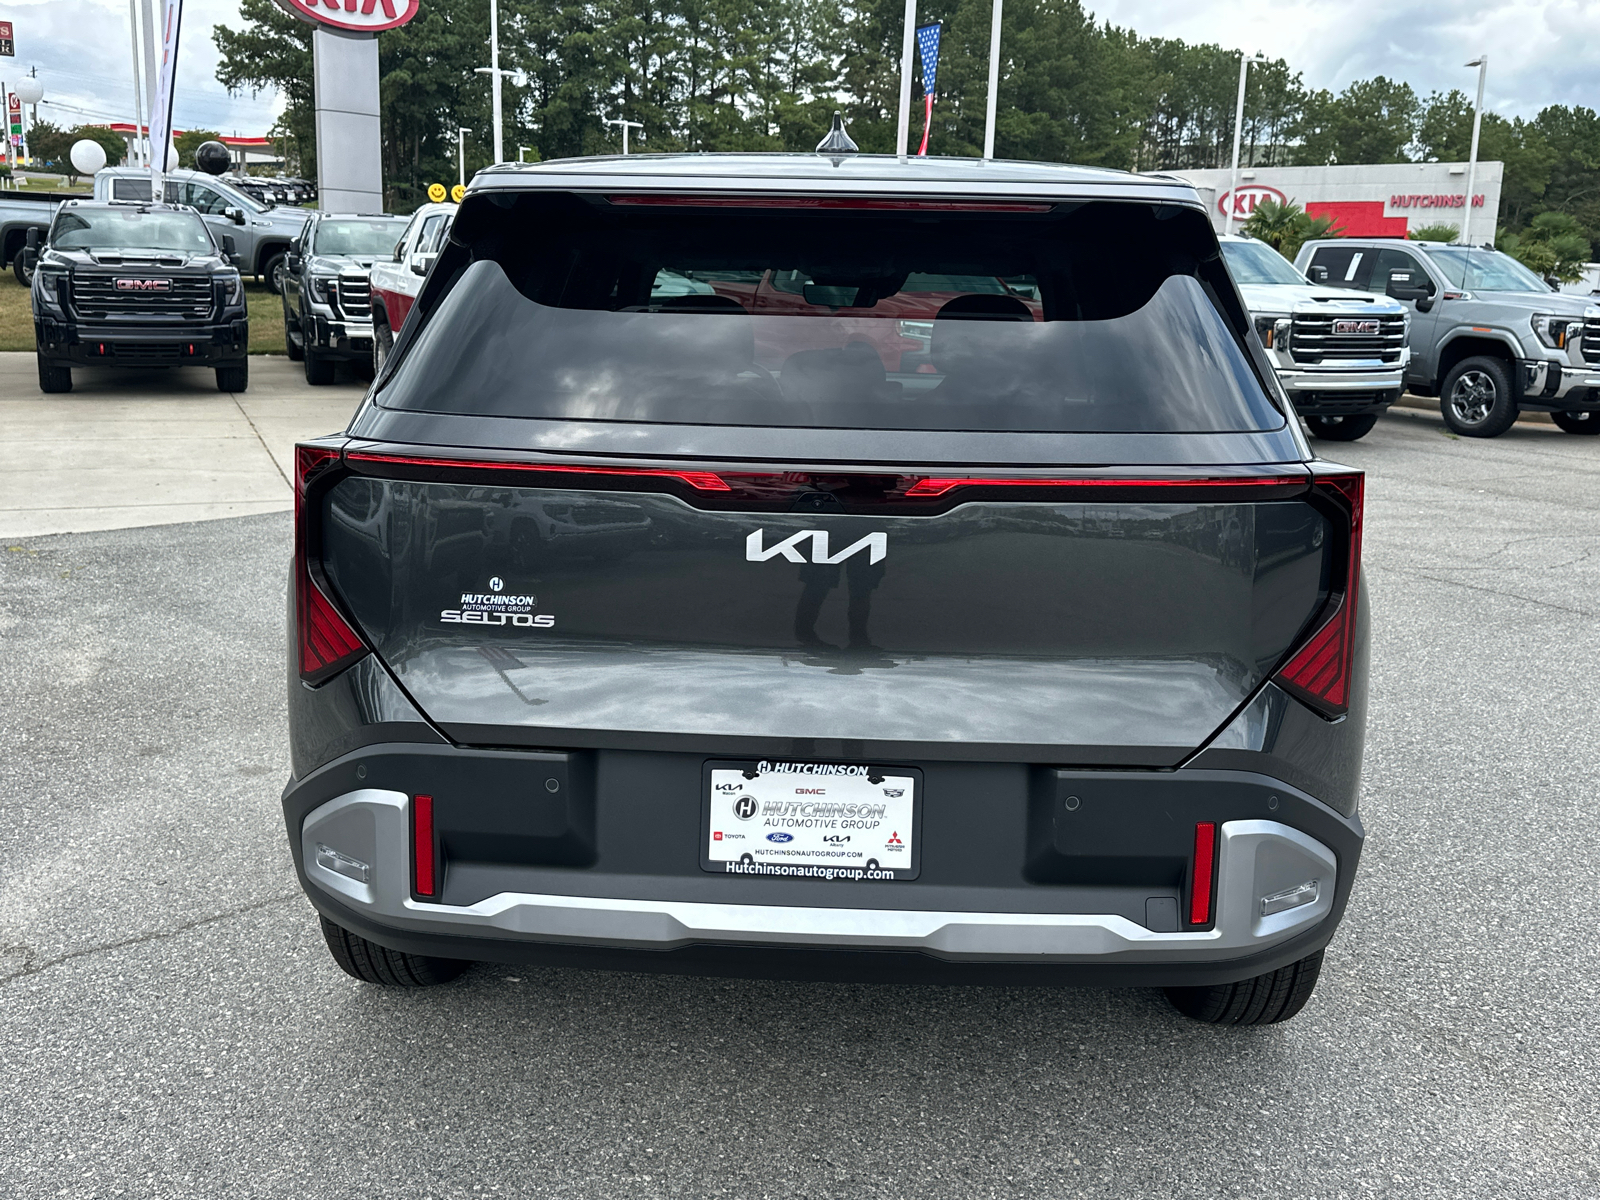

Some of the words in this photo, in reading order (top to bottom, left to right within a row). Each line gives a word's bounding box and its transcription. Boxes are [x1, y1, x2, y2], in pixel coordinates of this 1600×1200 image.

[117, 279, 169, 290] GMC
[1336, 321, 1377, 332] GMC
[746, 528, 887, 566] KIA
[460, 594, 534, 606] HUTCHINSON
[462, 604, 506, 612] AUTOMOTIVE
[507, 605, 531, 613] GROUP
[440, 609, 555, 628] SELTOS
[774, 763, 869, 777] HUTCHINSON
[761, 801, 887, 819] HUTCHINSON
[763, 818, 838, 829] AUTOMOTIVE
[840, 819, 880, 830] GROUP
[769, 833, 791, 842] Ford
[823, 835, 851, 843] KIA
[754, 849, 863, 858] HUTCHINSONAUTOGROUP.COM
[726, 861, 894, 881] Hutchinsonautogroup.com
